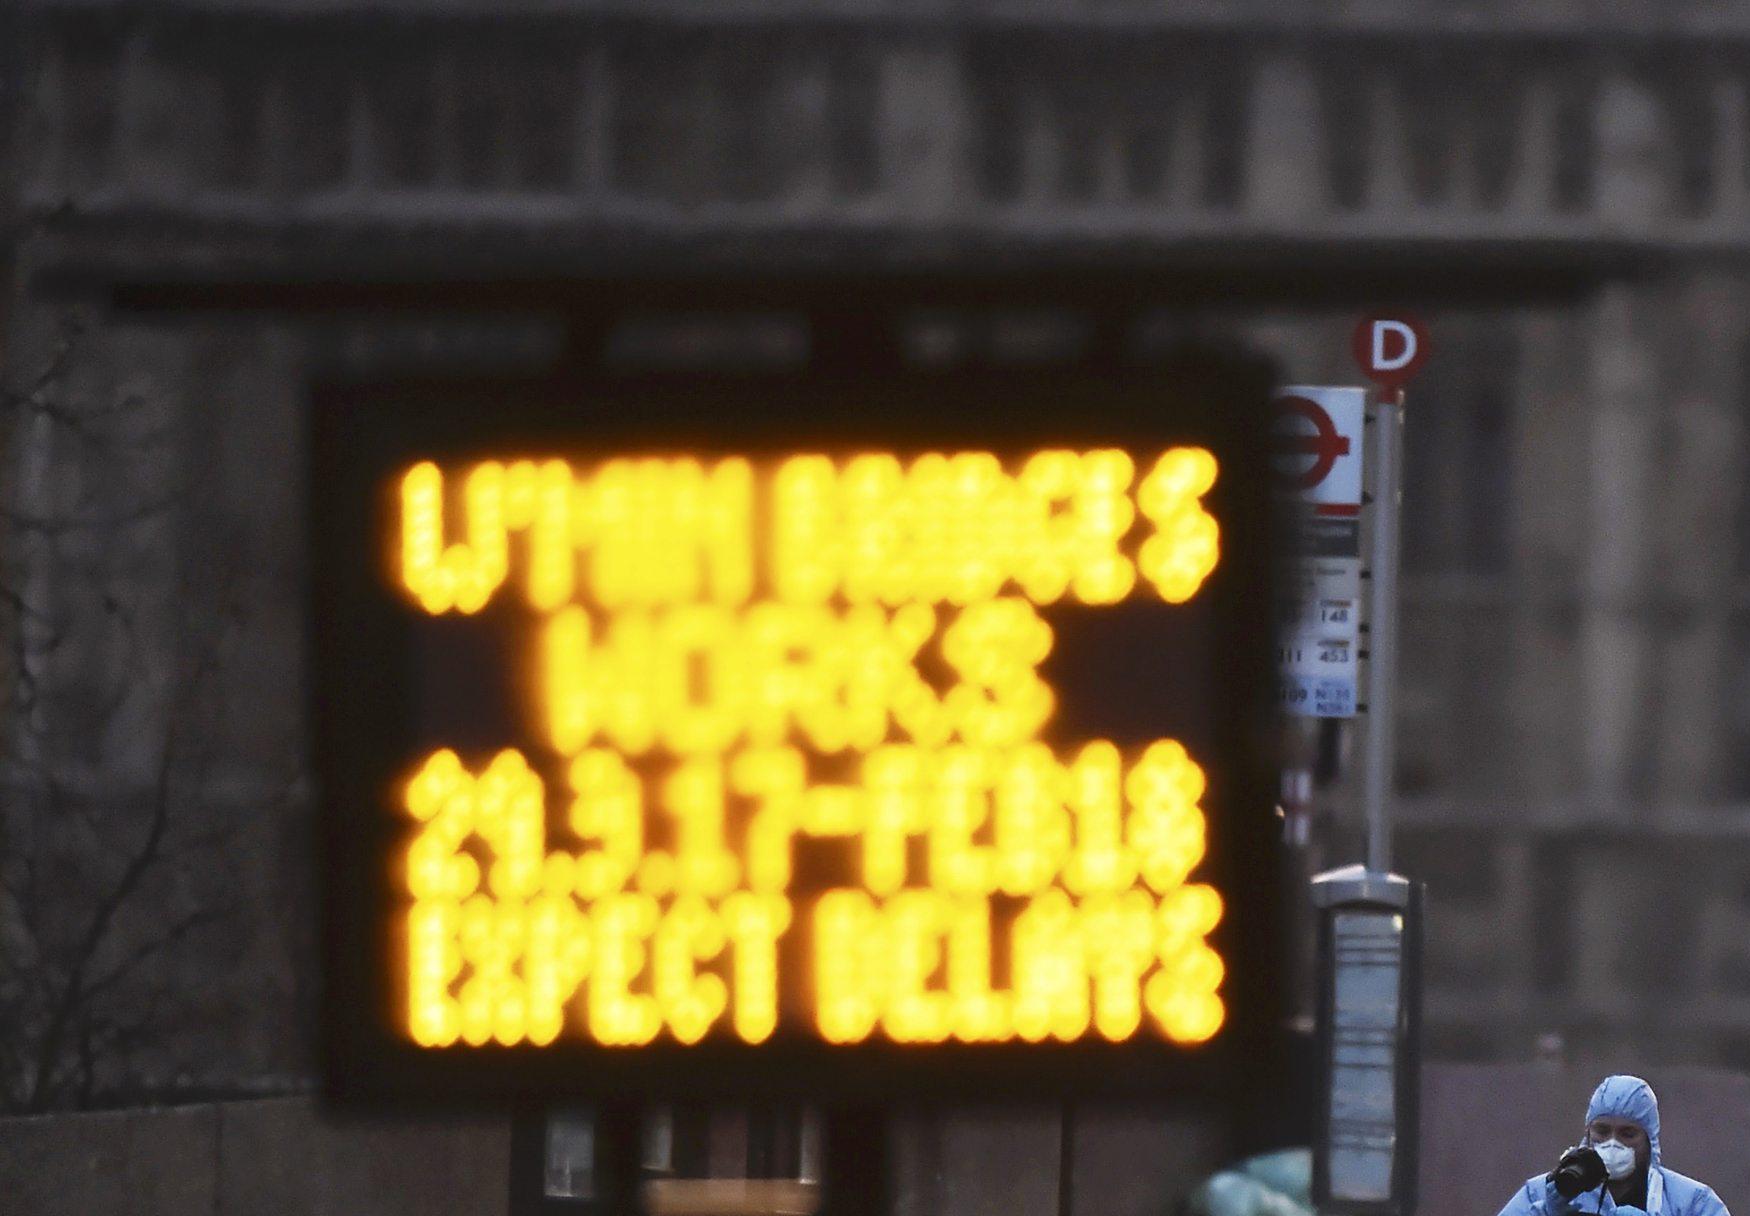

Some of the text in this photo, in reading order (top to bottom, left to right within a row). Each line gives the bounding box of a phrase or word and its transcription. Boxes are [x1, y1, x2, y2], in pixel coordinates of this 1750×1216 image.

[1373, 320, 1417, 370] D
[543, 598, 1055, 754] WORKS
[406, 884, 1225, 1046] EXPECT DELAYS
